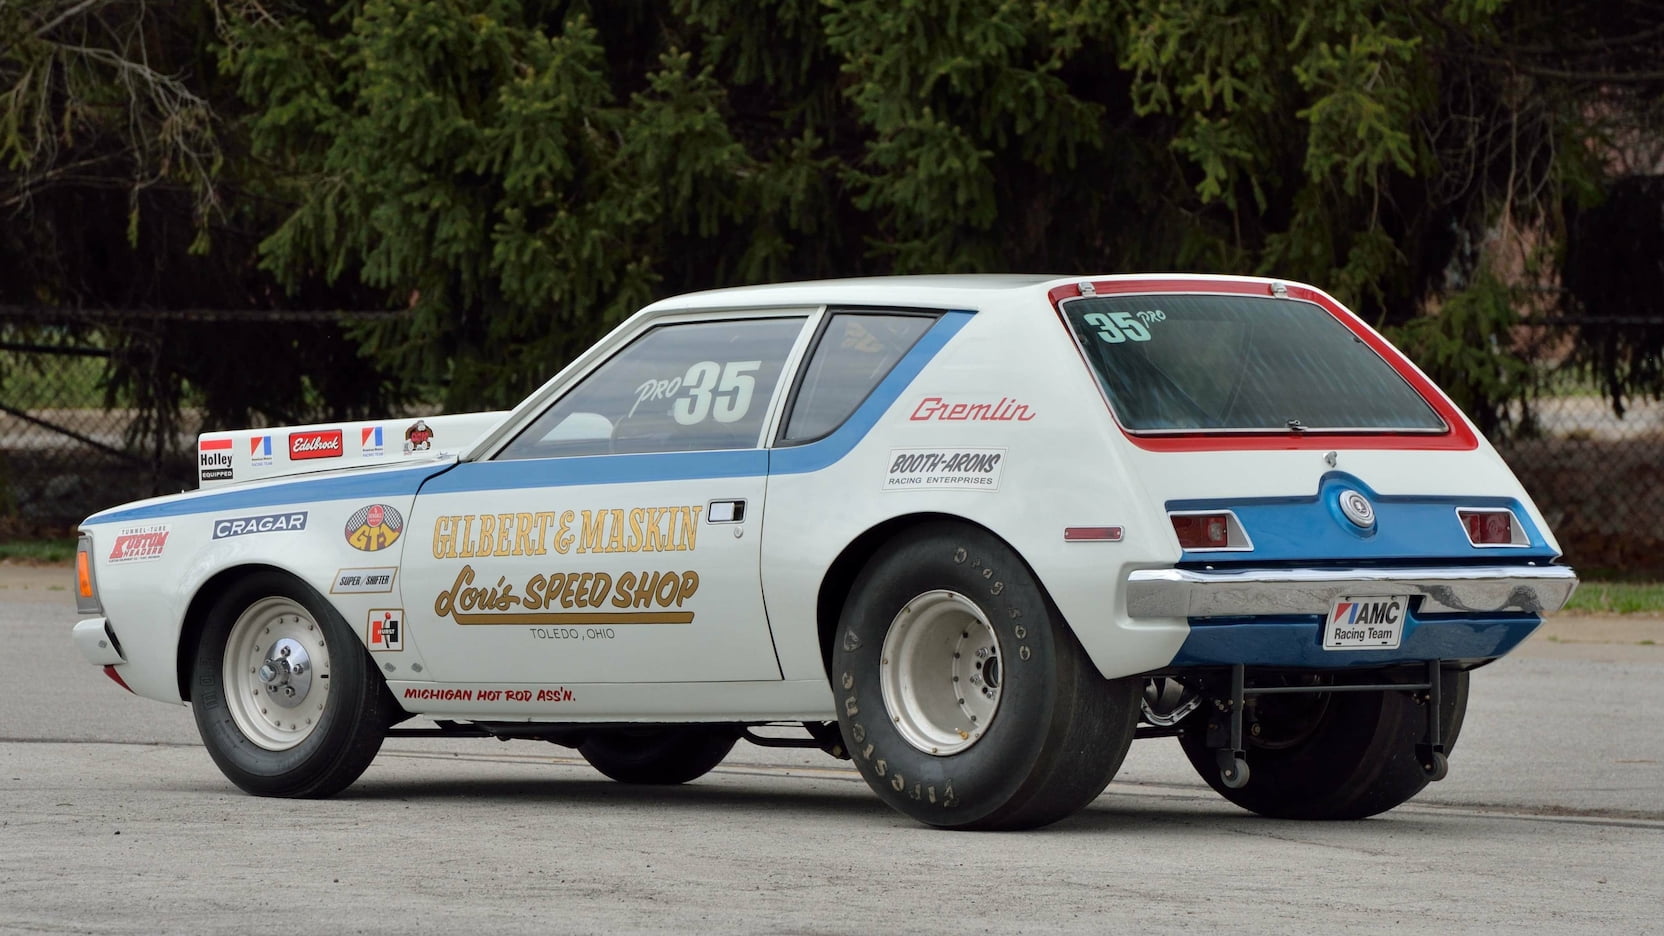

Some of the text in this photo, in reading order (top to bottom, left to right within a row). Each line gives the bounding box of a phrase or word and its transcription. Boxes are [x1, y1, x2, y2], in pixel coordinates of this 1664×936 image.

[1083, 310, 1167, 343] 35 PRO
[628, 360, 762, 426] PRO 35
[910, 397, 1036, 421] Gremlin
[293, 436, 340, 452] Edelbrock
[200, 453, 232, 468] Holley
[890, 453, 1001, 474] BOOTH-ARONS
[888, 476, 993, 485] RACING ENTERPRISES
[216, 515, 304, 537] CRAGAR
[433, 506, 704, 559] GILBERT & MASKIN
[109, 531, 169, 559] KUSTOM
[123, 547, 163, 557] HEADERS
[339, 575, 390, 586] SUPER SHIFTER
[522, 572, 612, 610] SPEED
[611, 570, 700, 609] SHOP
[1355, 602, 1400, 624] AMC
[586, 628, 616, 640] OHIO
[1334, 628, 1393, 642] Racing Team
[404, 686, 577, 703] MICHIGAN HOT ROD ASS'N.
